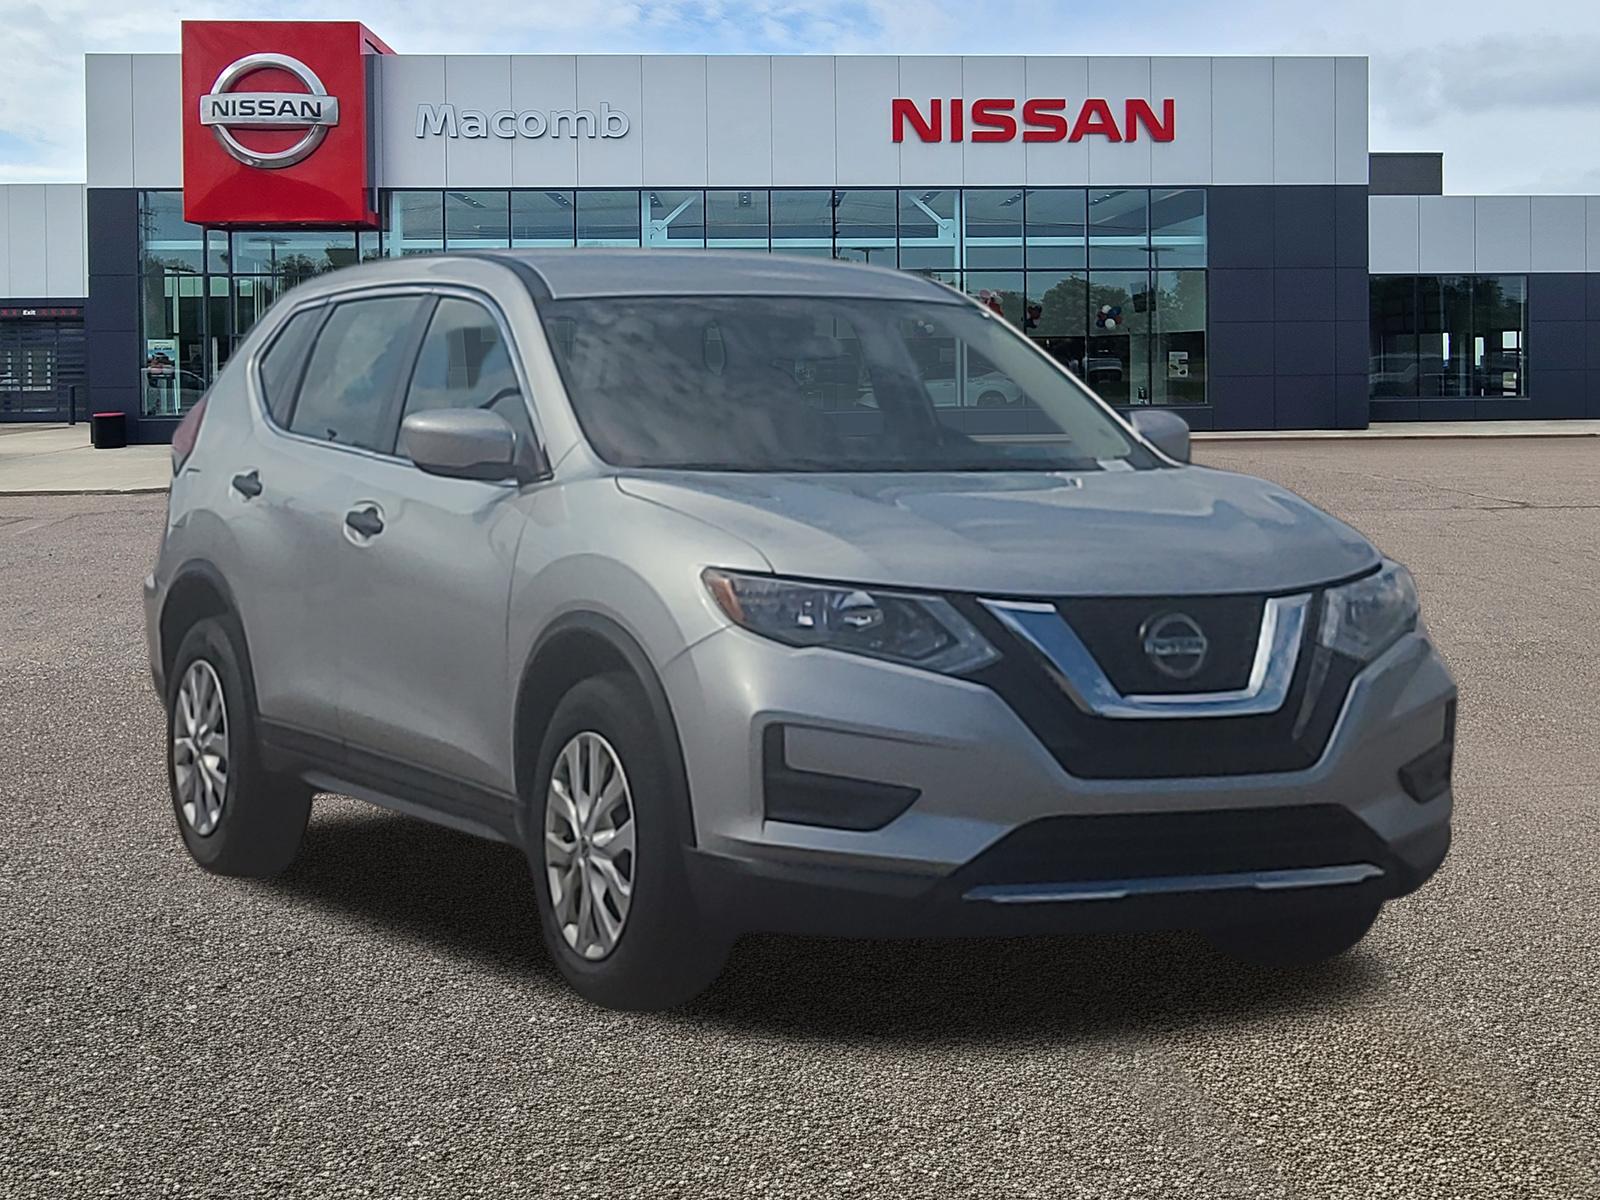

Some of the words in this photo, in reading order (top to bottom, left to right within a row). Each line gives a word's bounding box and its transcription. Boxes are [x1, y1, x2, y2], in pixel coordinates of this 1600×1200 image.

[212, 100, 322, 117] NISSAN
[415, 102, 630, 139] Macomb
[892, 98, 1175, 143] NISSAN
